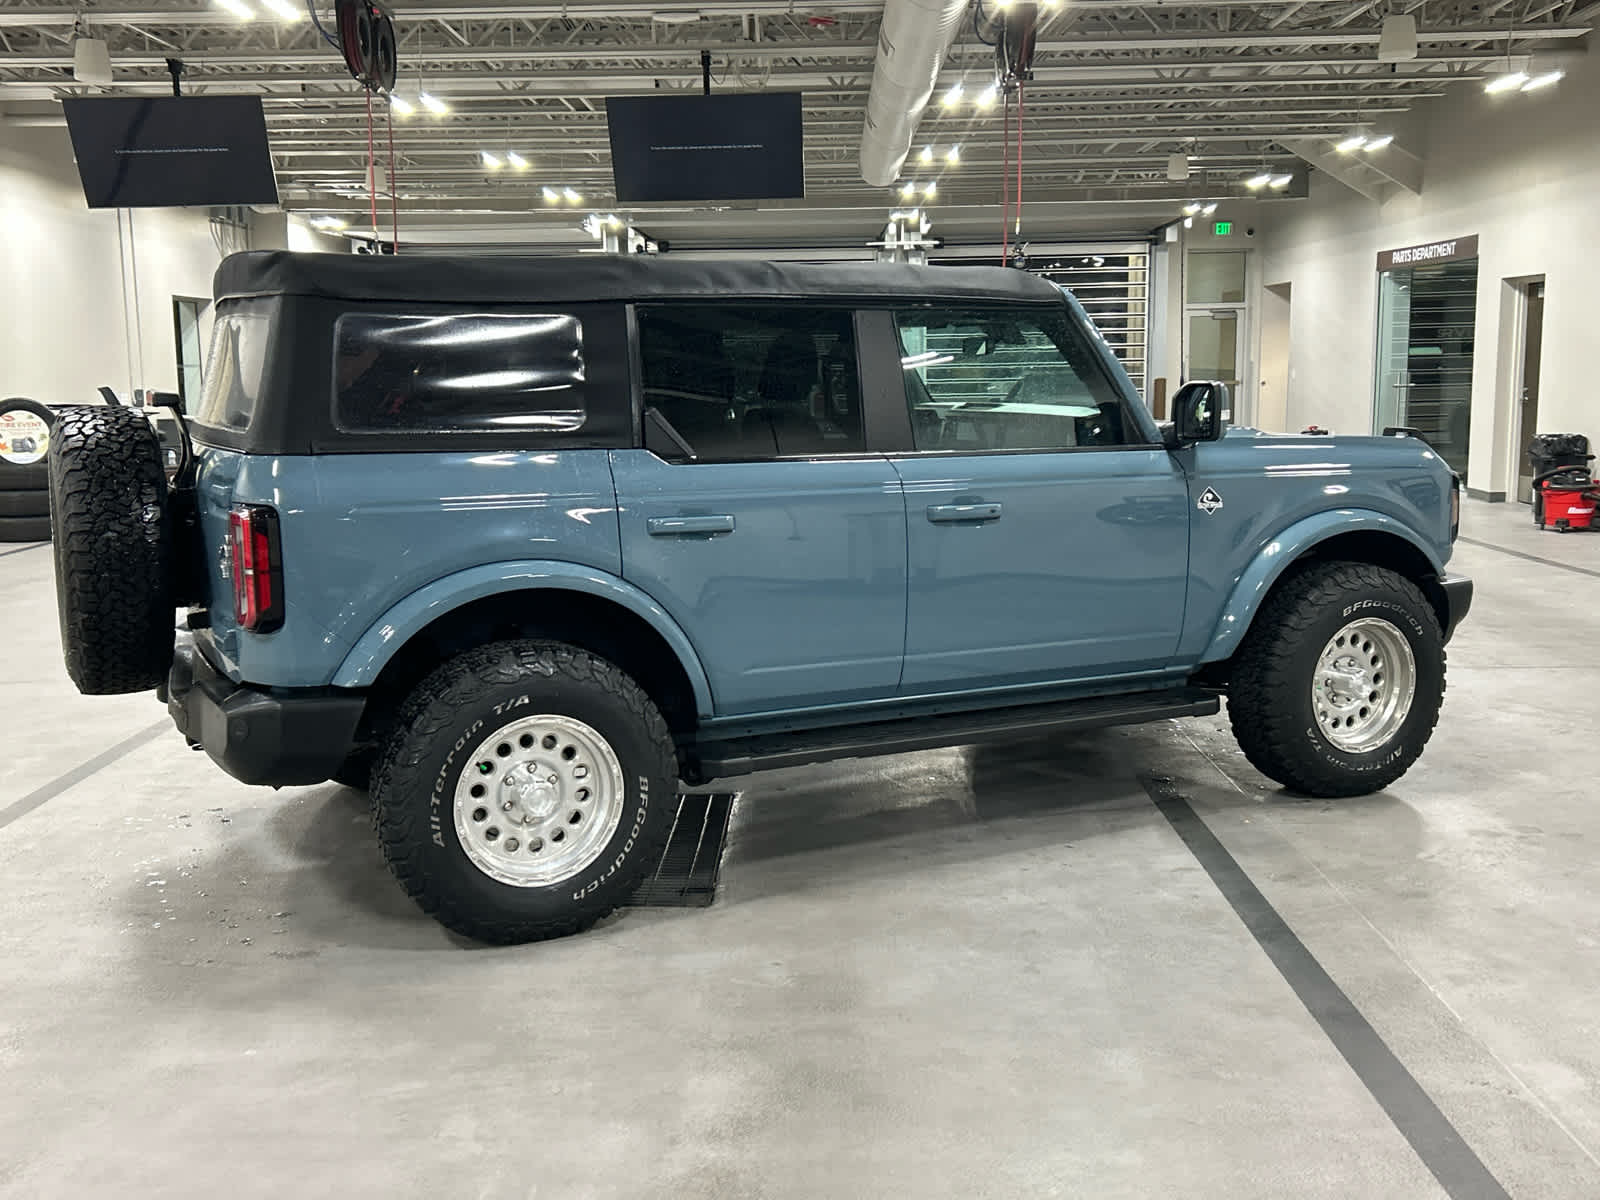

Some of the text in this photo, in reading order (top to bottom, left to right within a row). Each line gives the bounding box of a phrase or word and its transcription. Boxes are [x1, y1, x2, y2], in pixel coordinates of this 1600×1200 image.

[1216, 222, 1232, 235] EXIT
[1392, 242, 1457, 264] PARTS DEPARTMENT
[1343, 599, 1424, 636] BFGoodrich
[430, 694, 531, 849] All-Terrain T/A
[572, 775, 650, 901] BFGoodrich
